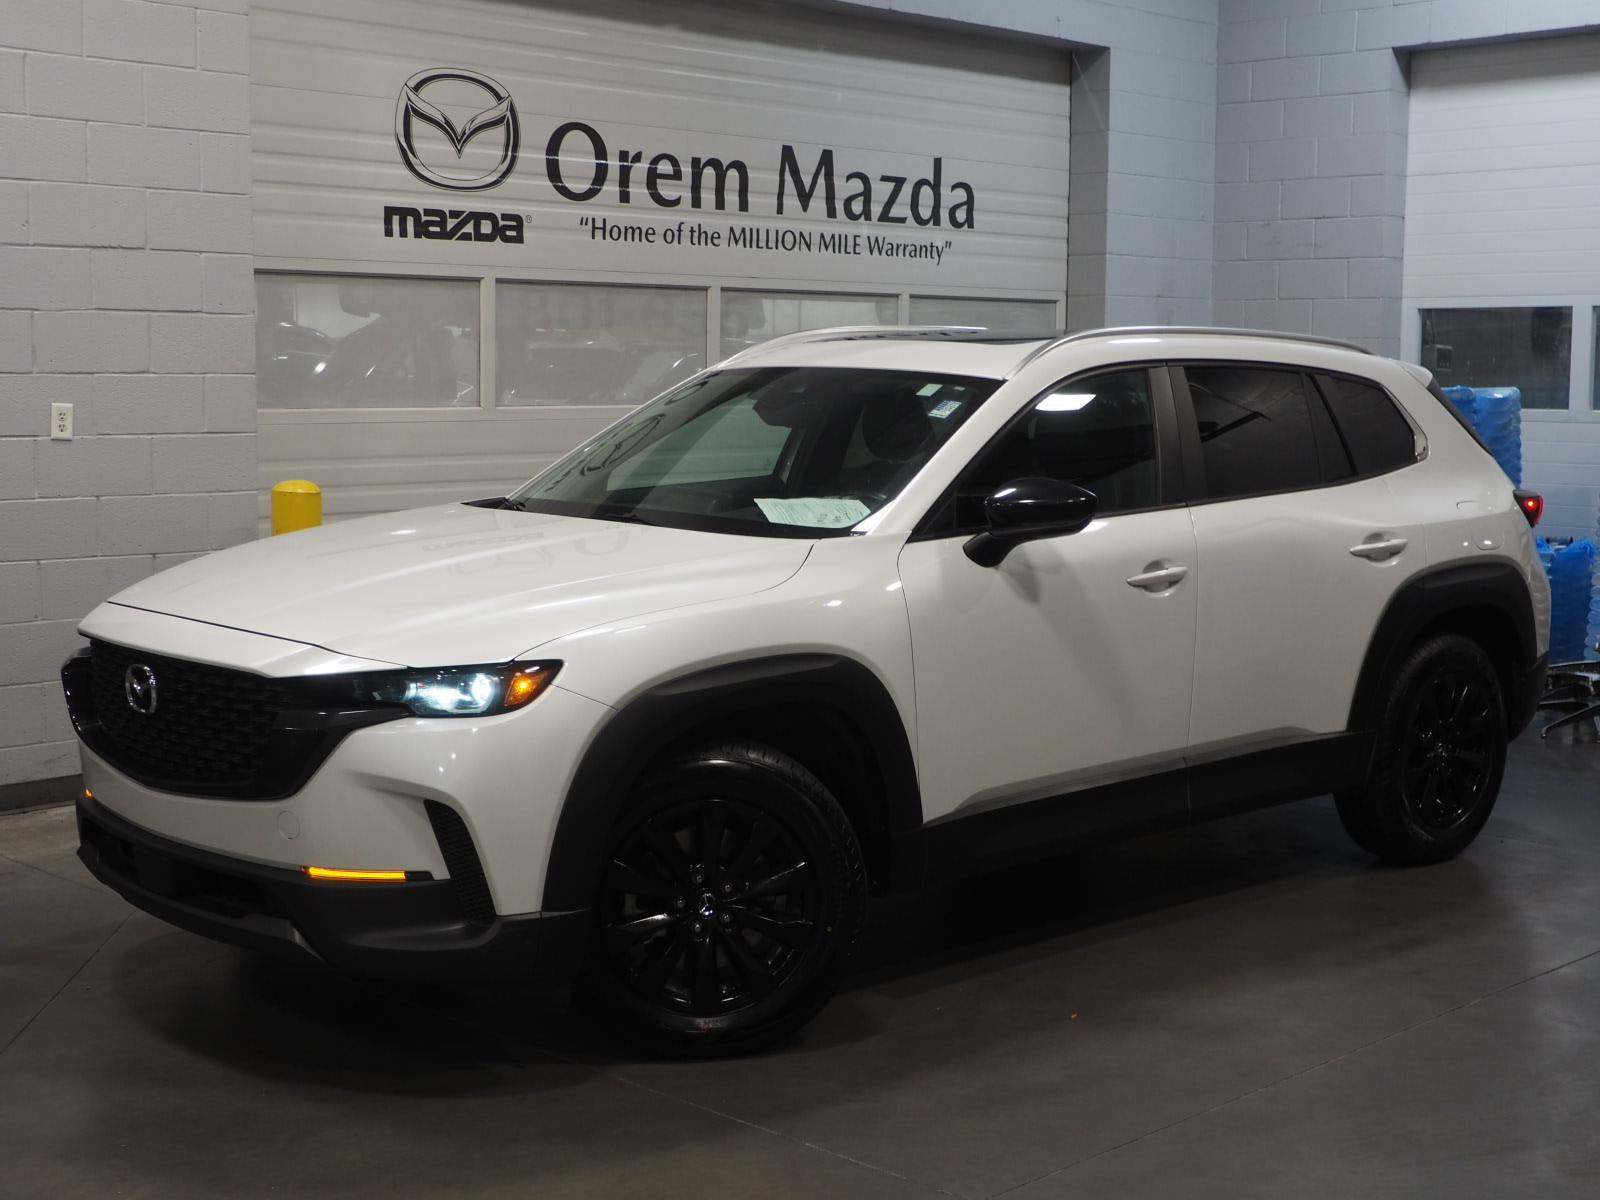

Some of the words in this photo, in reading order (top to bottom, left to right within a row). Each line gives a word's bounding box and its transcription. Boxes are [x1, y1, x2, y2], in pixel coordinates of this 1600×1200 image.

[545, 121, 750, 214] Orem
[776, 144, 976, 230] Mazda
[662, 221, 685, 246] of
[689, 223, 721, 247] the
[727, 226, 812, 252] MILLION
[818, 233, 862, 255] MILE
